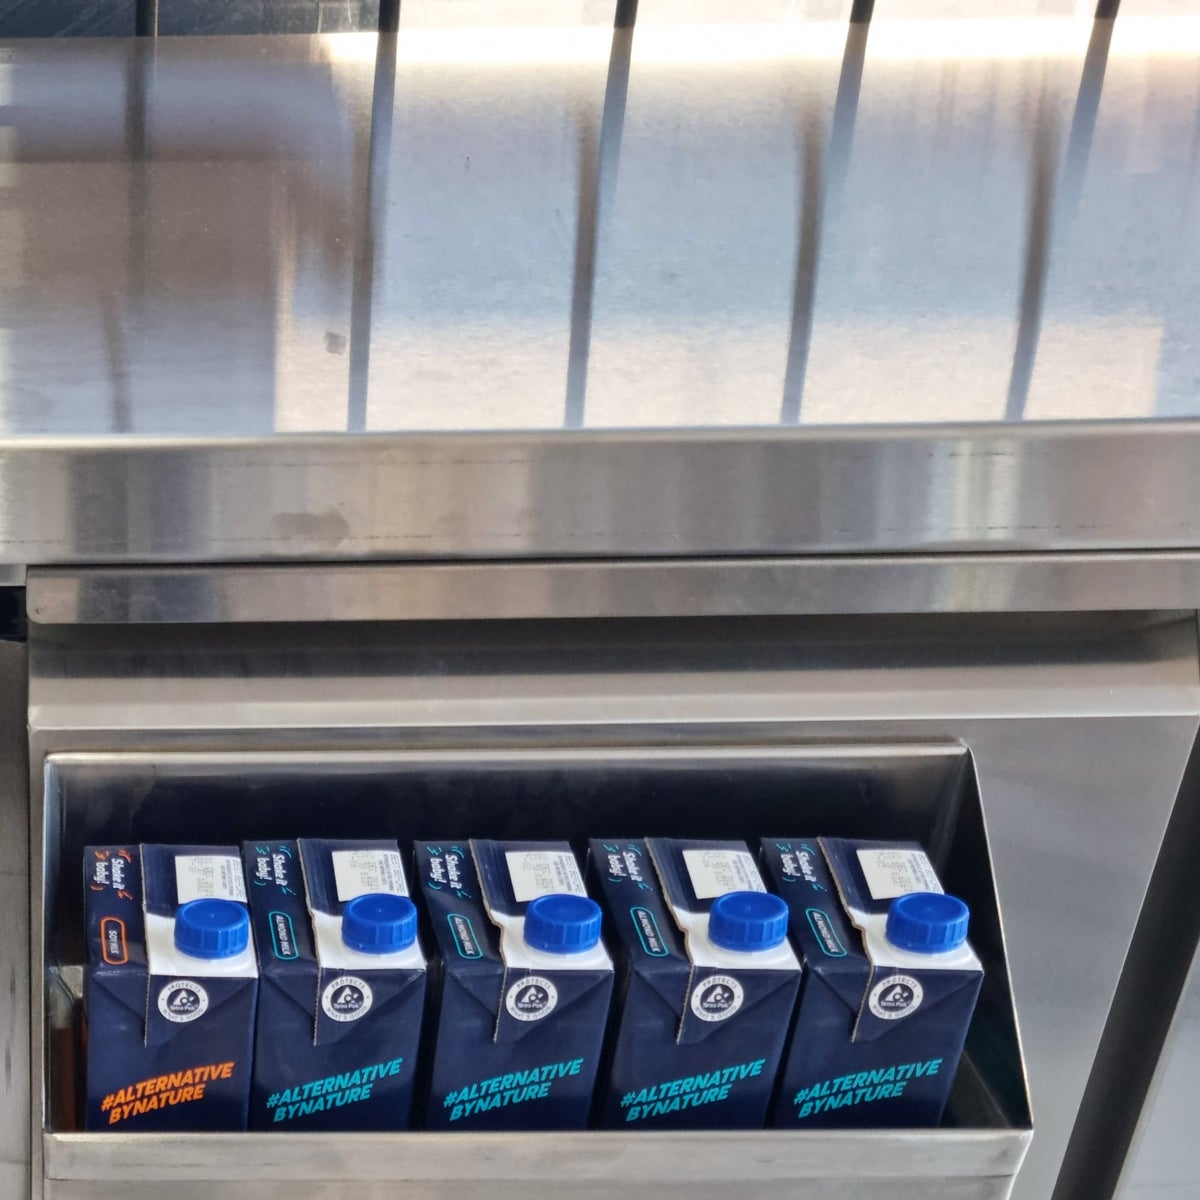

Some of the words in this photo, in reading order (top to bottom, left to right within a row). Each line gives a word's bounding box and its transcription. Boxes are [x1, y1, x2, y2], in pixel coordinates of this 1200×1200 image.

[93, 862, 110, 884] baby!
[111, 858, 125, 882] Shake
[255, 857, 272, 881] baby!
[272, 854, 287, 878] Shake
[430, 858, 447, 883] baby!
[445, 854, 461, 881] Shake
[608, 854, 627, 876] baby!
[623, 851, 640, 875] Shake
[781, 853, 801, 876] baby!
[796, 850, 814, 875] Shake
[276, 915, 288, 940] ALMOND
[454, 917, 469, 940] ALMOND
[637, 910, 654, 937] ALMOND
[812, 911, 831, 938] ALMOND
[331, 978, 366, 990] PROTECTS
[101, 1061, 235, 1112] #ALTERNATIVE
[266, 1057, 403, 1109] #ALTERNATIVE
[443, 1058, 584, 1108] #ALTERNATIVE
[620, 1058, 765, 1108] #ALTERNATIVE
[793, 1058, 943, 1105] #ALTERNATIVE
[108, 1083, 206, 1125] BYNATURE
[273, 1083, 373, 1122] BYNATURE
[449, 1081, 552, 1121] BYNATURE
[626, 1083, 733, 1122] BYNATURE
[798, 1081, 907, 1119] BYNATURE
